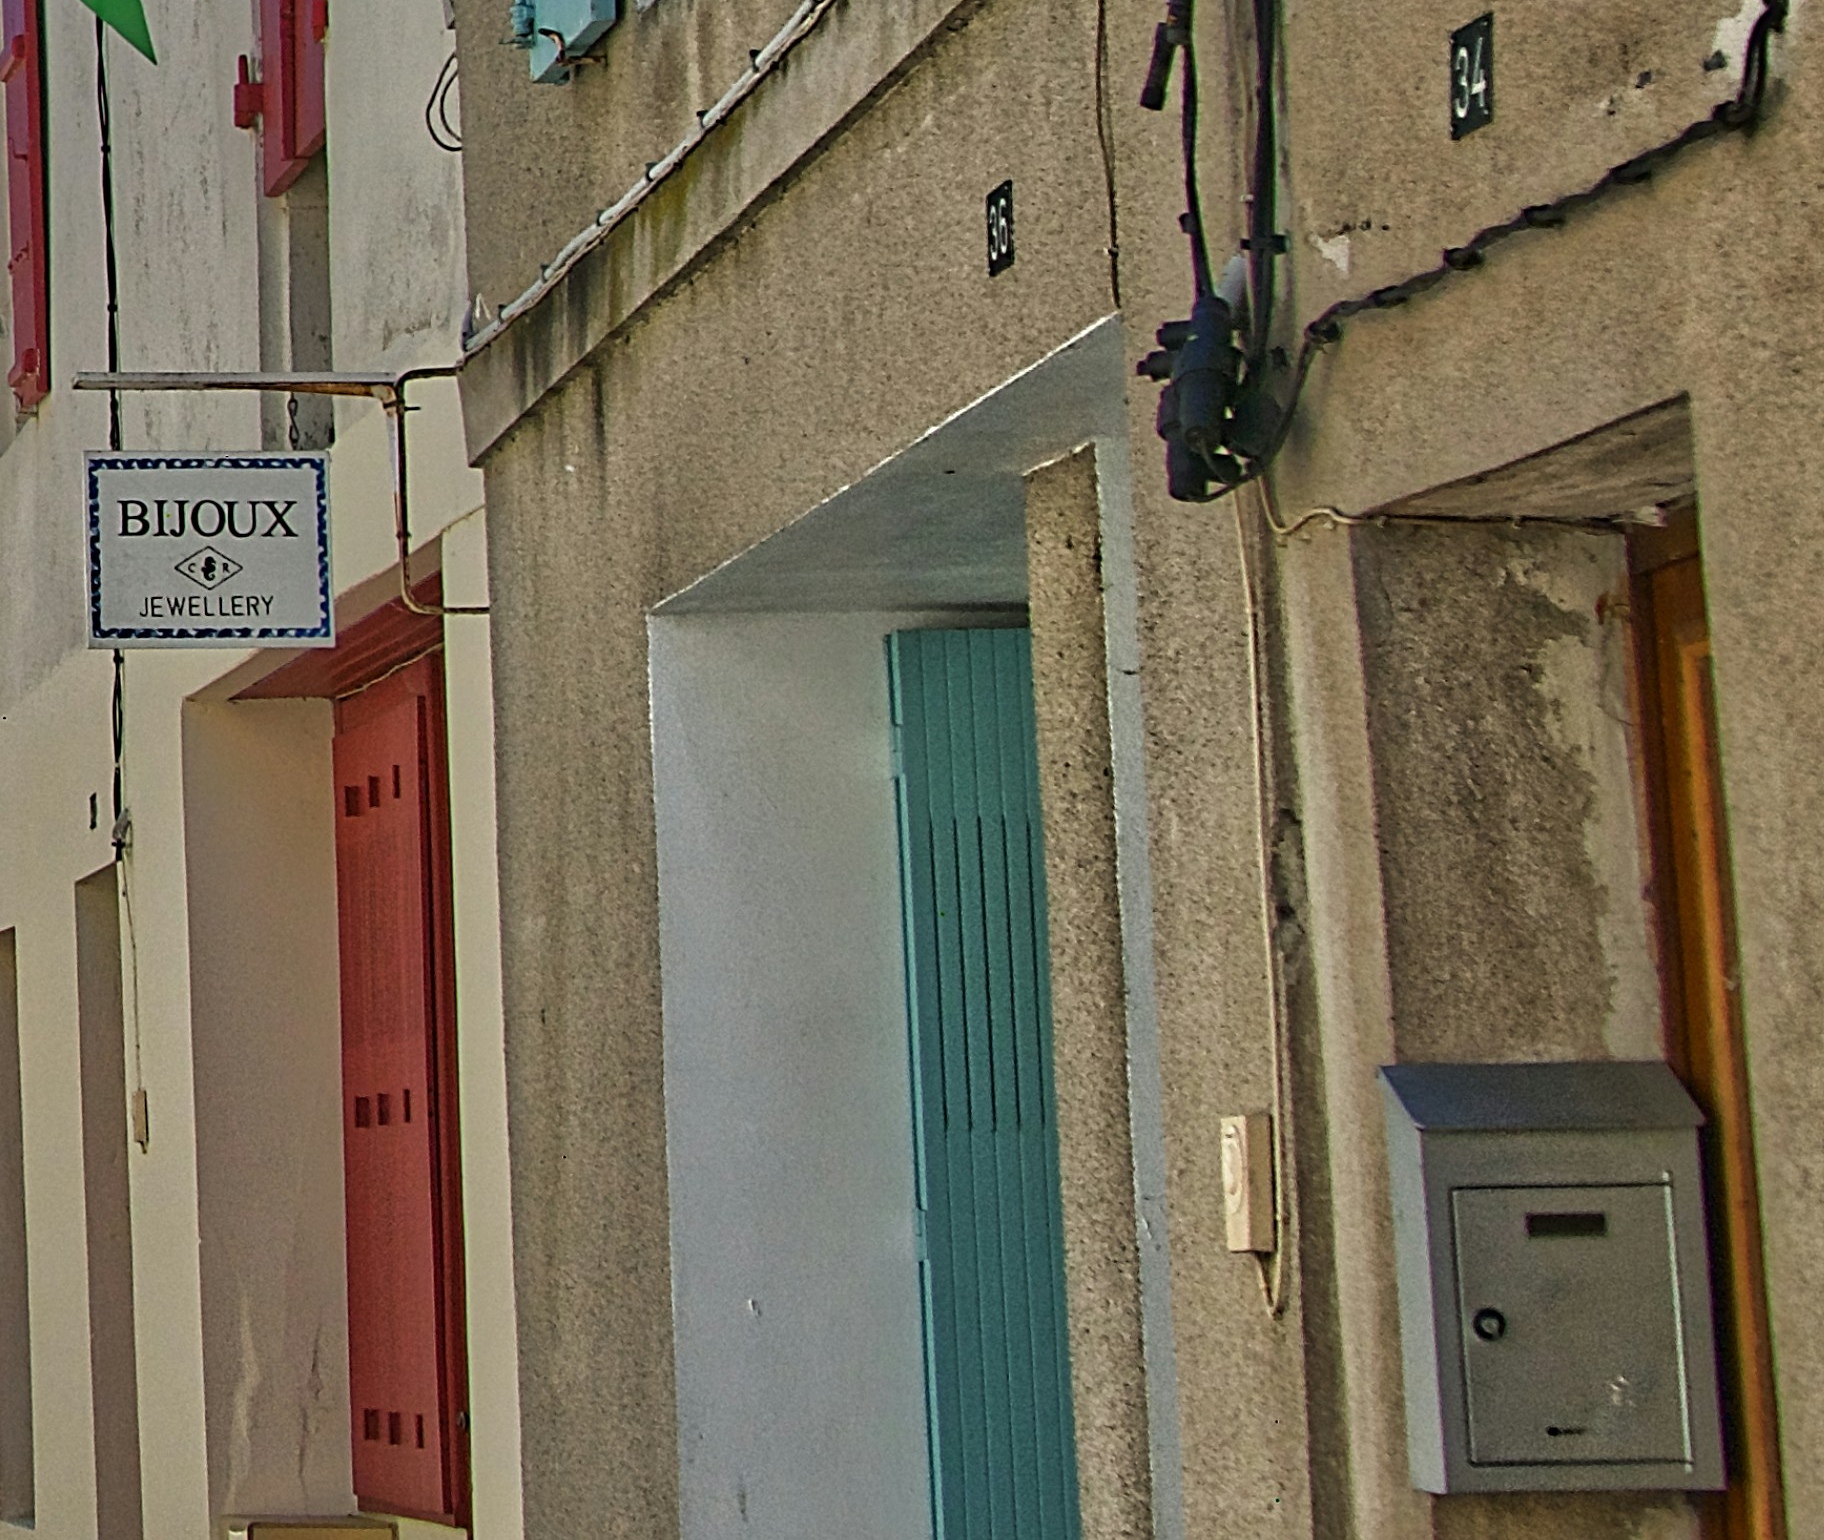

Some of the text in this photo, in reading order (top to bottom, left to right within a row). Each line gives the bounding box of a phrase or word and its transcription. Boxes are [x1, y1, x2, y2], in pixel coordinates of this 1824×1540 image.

[1455, 37, 1487, 118] 34
[989, 198, 1008, 260] 36
[117, 499, 298, 538] BIJOUX
[188, 562, 230, 573] C R
[139, 595, 274, 618] JEWELLERY
